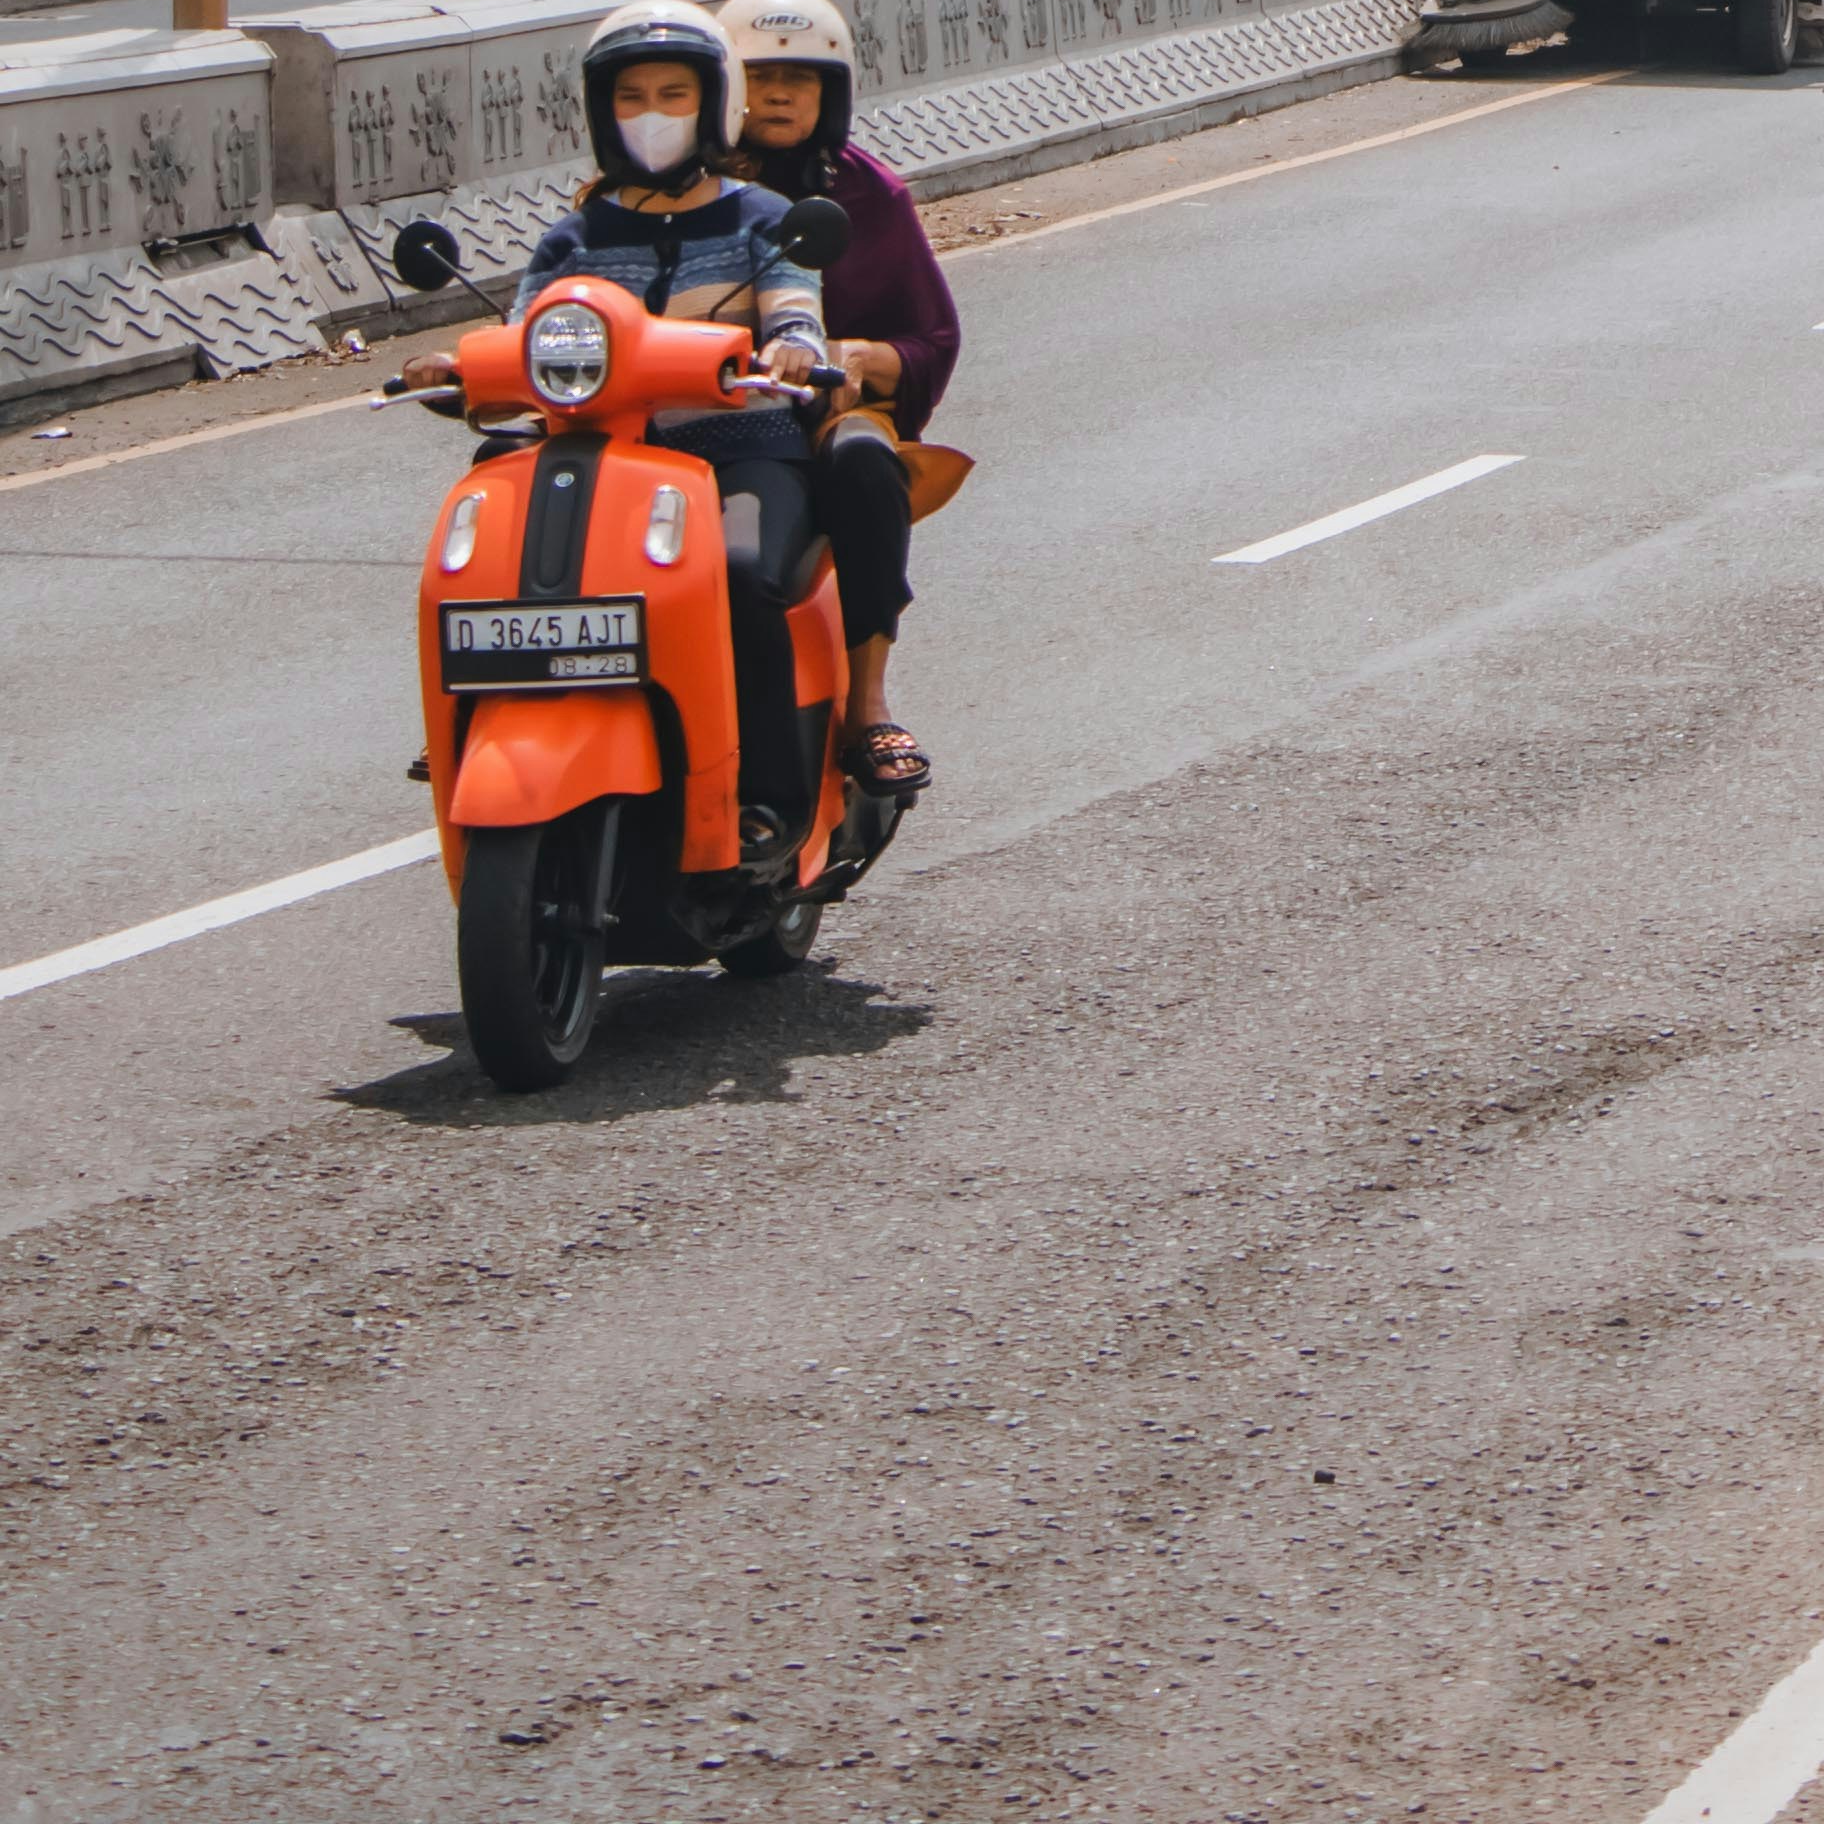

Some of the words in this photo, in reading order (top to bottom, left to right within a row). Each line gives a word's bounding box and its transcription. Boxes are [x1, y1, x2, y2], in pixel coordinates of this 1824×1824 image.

[459, 620, 474, 651] D
[490, 616, 563, 650] 3645
[577, 614, 627, 645] AJT
